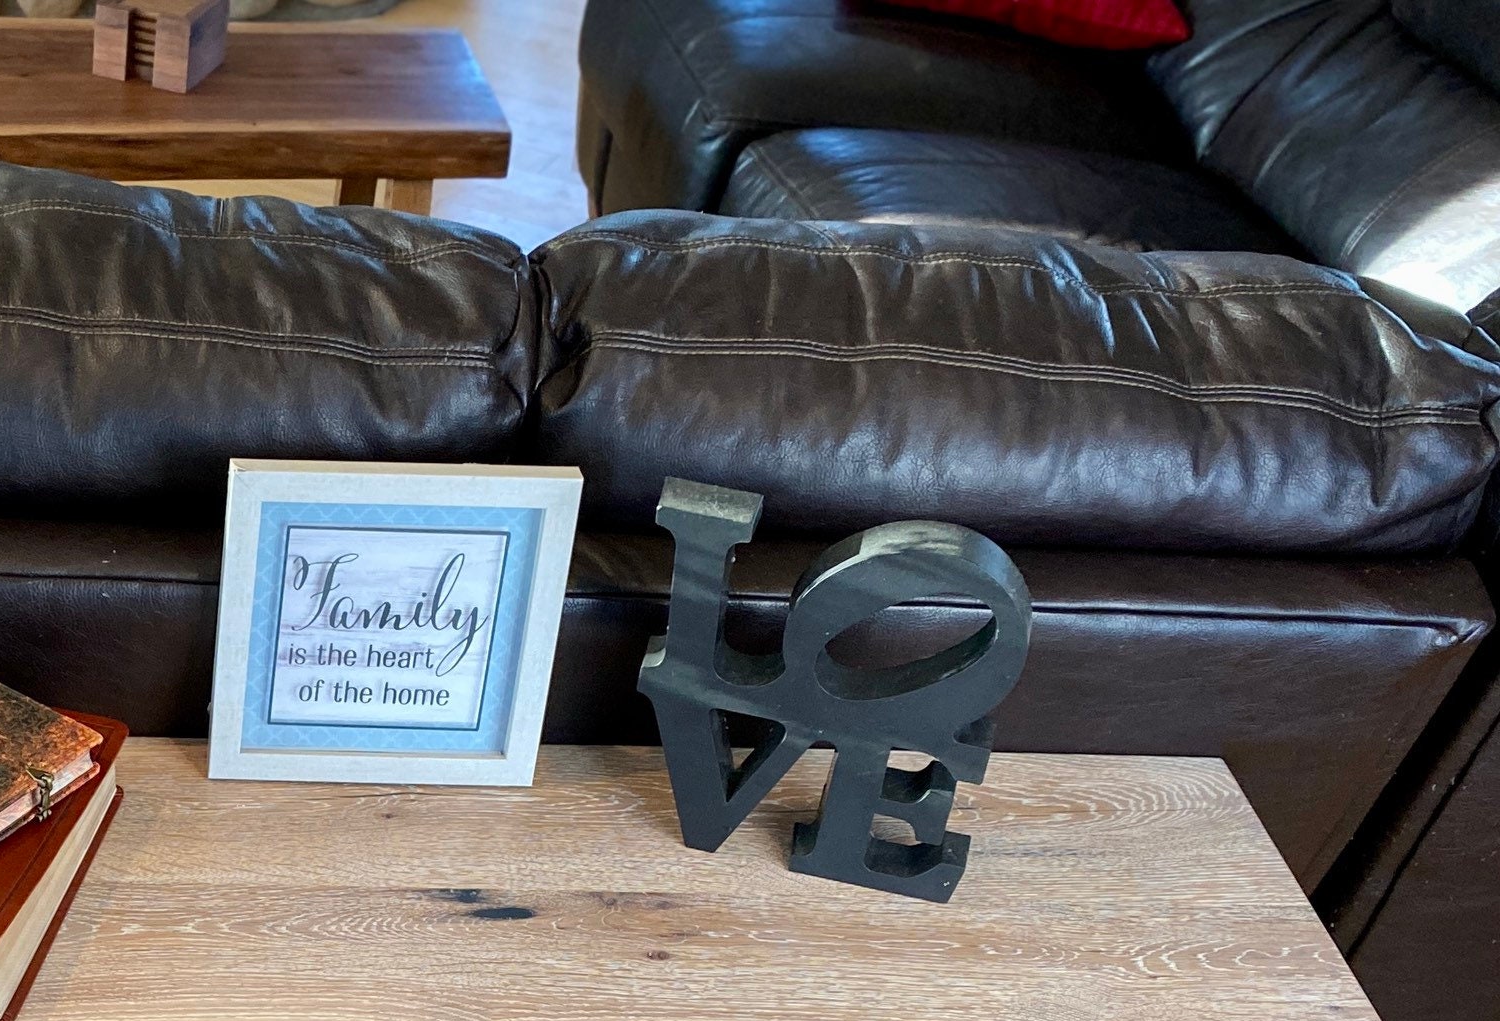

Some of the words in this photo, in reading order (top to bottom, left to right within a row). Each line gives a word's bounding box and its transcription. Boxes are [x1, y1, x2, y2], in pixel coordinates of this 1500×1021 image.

[292, 553, 489, 678] Family
[288, 643, 307, 666] is
[317, 643, 357, 667] the
[366, 644, 435, 669] heart
[299, 679, 325, 702] of
[333, 681, 373, 704] the
[382, 682, 450, 706] home
